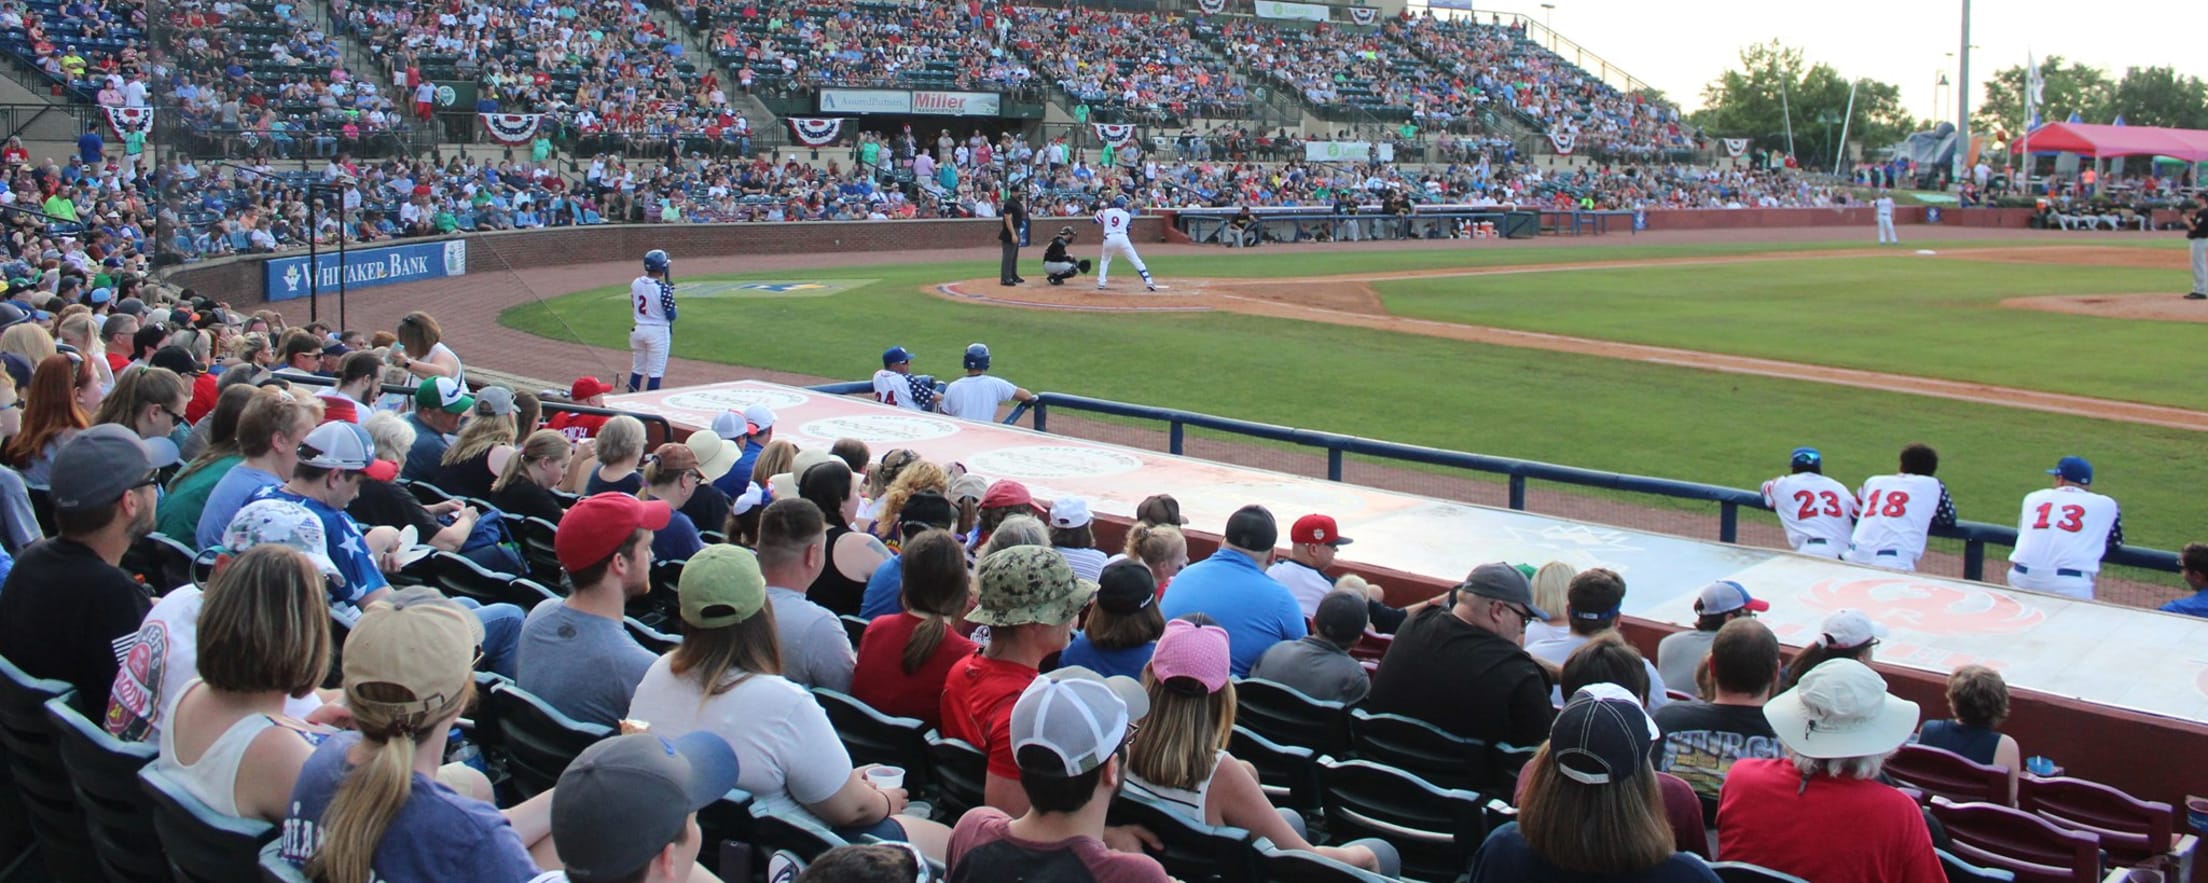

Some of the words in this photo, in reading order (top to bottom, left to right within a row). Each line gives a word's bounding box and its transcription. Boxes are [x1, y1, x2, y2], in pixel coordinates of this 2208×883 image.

[915, 93, 966, 108] Miller
[1111, 216, 1120, 227] 9
[638, 295, 647, 315] 2
[561, 425, 588, 440] ENCH
[1793, 489, 1843, 520] 23
[1864, 489, 1910, 518] 18
[2032, 502, 2086, 533] 13
